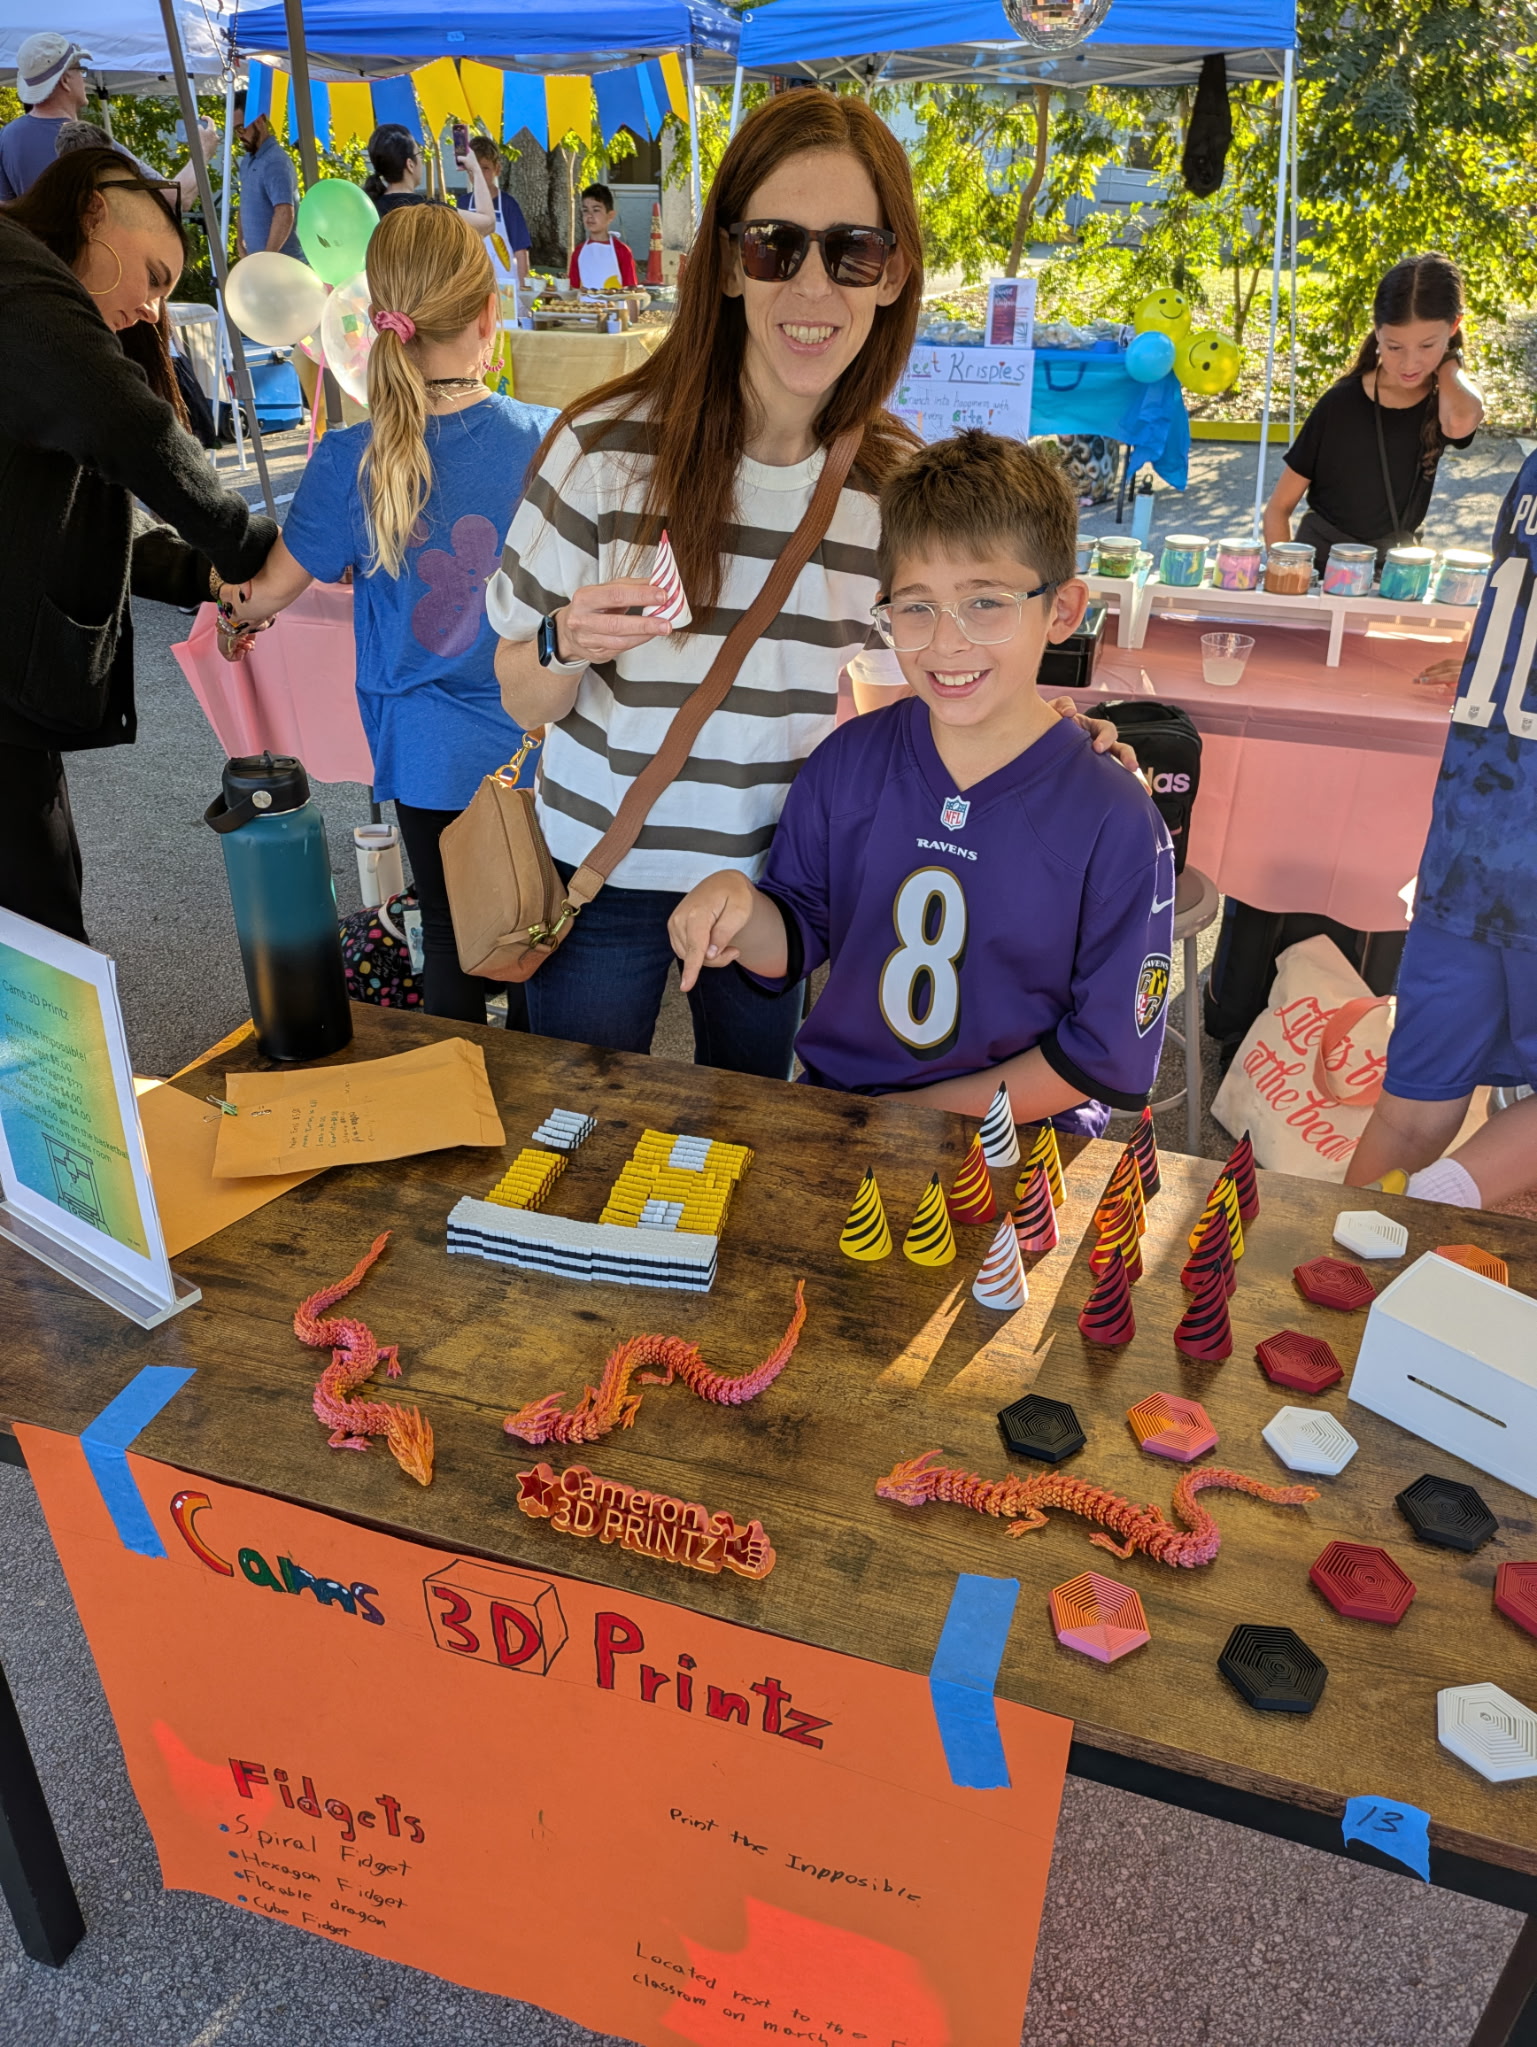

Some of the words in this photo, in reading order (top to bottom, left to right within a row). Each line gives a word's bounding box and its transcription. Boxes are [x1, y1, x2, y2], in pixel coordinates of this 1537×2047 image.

[912, 352, 941, 374] eet
[949, 351, 1025, 381] Krispies
[944, 810, 962, 825] NFL
[916, 838, 978, 861] RAVENS
[879, 866, 968, 1049] 8
[1143, 959, 1169, 970] RAVENS
[2, 980, 26, 999] Cams
[28, 993, 39, 1005] 3D
[42, 1000, 68, 1020] Printz
[5, 1014, 24, 1029] Print
[26, 1025, 39, 1038] the
[554, 1496, 594, 1532] 3D
[603, 1508, 720, 1567] PRINTZ
[170, 1490, 386, 1626] Cams
[431, 1586, 542, 1667] 3D
[594, 1611, 833, 1750] Printz
[228, 1757, 426, 1844] Fidgets
[1356, 1806, 1404, 1833] 13
[235, 1813, 317, 1853] Spiral
[341, 1845, 413, 1877] Fidget
[670, 1808, 719, 1832] Print
[731, 1830, 769, 1856] the
[241, 1848, 321, 1884] Hexagon
[337, 1877, 409, 1909] Fidget
[253, 1896, 290, 1917] Cube
[302, 1911, 352, 1938] Fidget
[330, 1899, 387, 1929] dragon
[636, 1941, 717, 1991] Located
[733, 1989, 772, 2009] next
[791, 2008, 811, 2022] to
[723, 2007, 746, 2023] on
